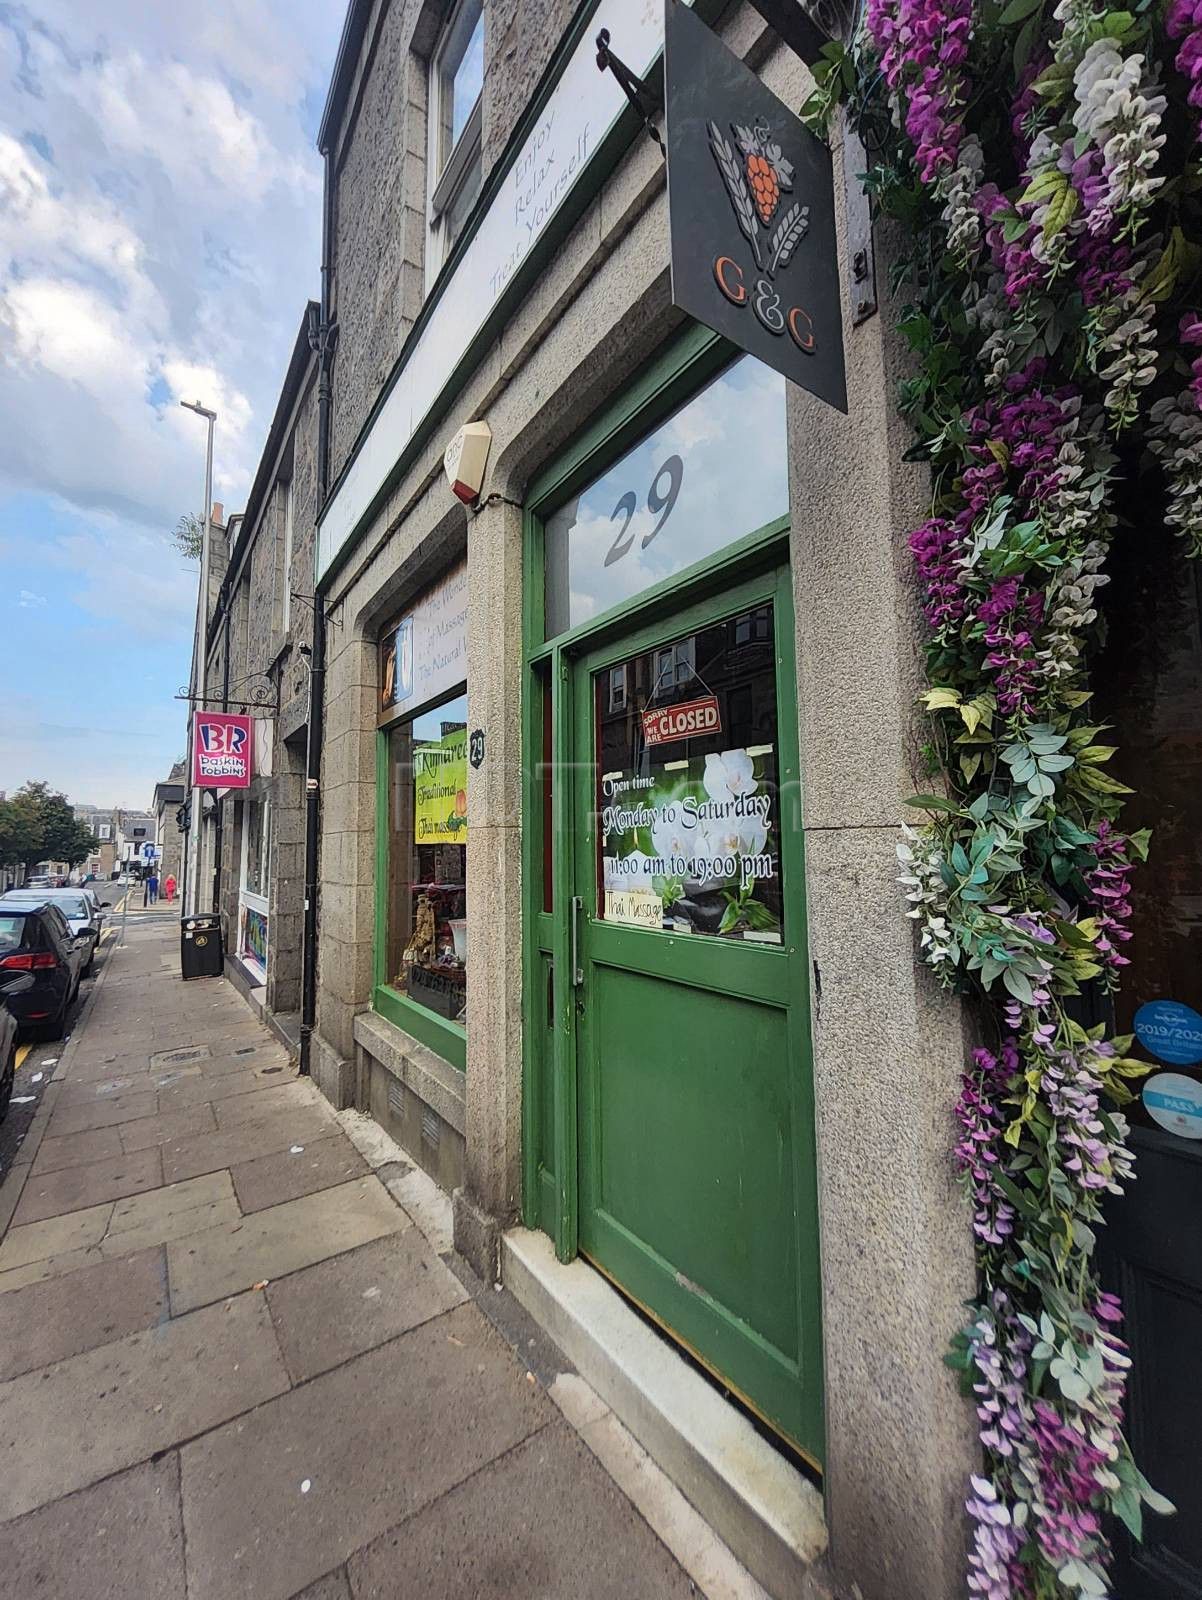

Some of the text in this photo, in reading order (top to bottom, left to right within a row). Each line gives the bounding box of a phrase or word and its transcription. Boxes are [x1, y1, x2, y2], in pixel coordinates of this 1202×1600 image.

[514, 110, 556, 189] Enjoy
[514, 148, 556, 225] Relax
[526, 121, 592, 240] Yourself
[712, 256, 746, 305] G
[787, 307, 815, 351] G
[604, 454, 684, 567] 29
[643, 709, 668, 728] SORRY
[647, 706, 718, 744] ARE CLOSED
[647, 726, 658, 736] WE
[199, 723, 247, 754] BR
[471, 736, 484, 762] 29
[417, 779, 457, 806] Traditional
[602, 774, 656, 797] Open time
[418, 817, 434, 840] Thai
[602, 792, 772, 836] Monday to Saturday
[609, 853, 774, 890] 11:00 am to 19:00 pm
[606, 890, 662, 926] Thai Massage
[1137, 1023, 1202, 1041] 2019/202
